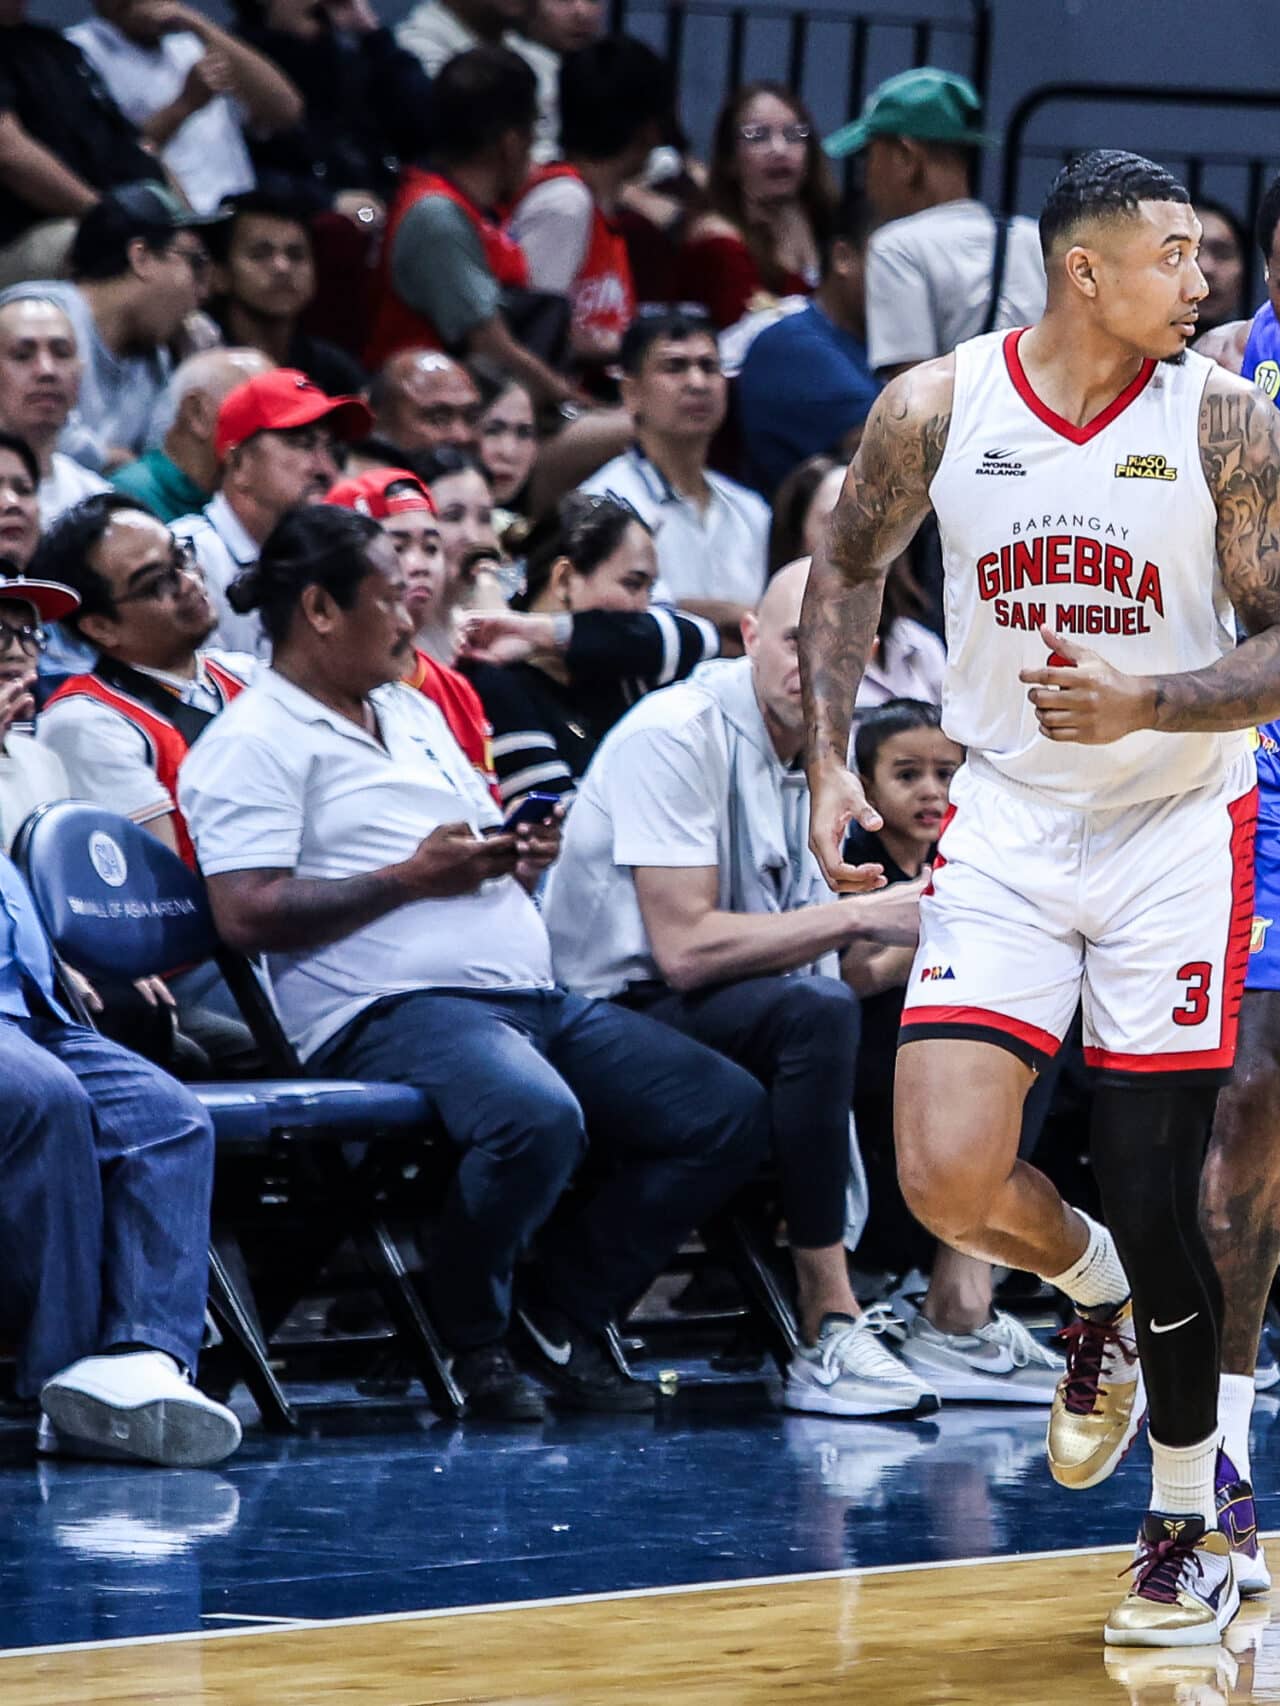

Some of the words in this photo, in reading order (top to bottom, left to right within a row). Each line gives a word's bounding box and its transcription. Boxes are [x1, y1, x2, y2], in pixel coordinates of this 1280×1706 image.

[975, 469, 1027, 477] BALANCE
[982, 461, 1022, 469] WORLD
[1116, 464, 1177, 480] FINALS
[1012, 514, 1129, 540] BARANGAY
[976, 535, 1164, 619] GINEBRA
[994, 599, 1046, 631] SAN
[1056, 604, 1151, 635] MIGUEL
[1172, 960, 1213, 1026] 3
